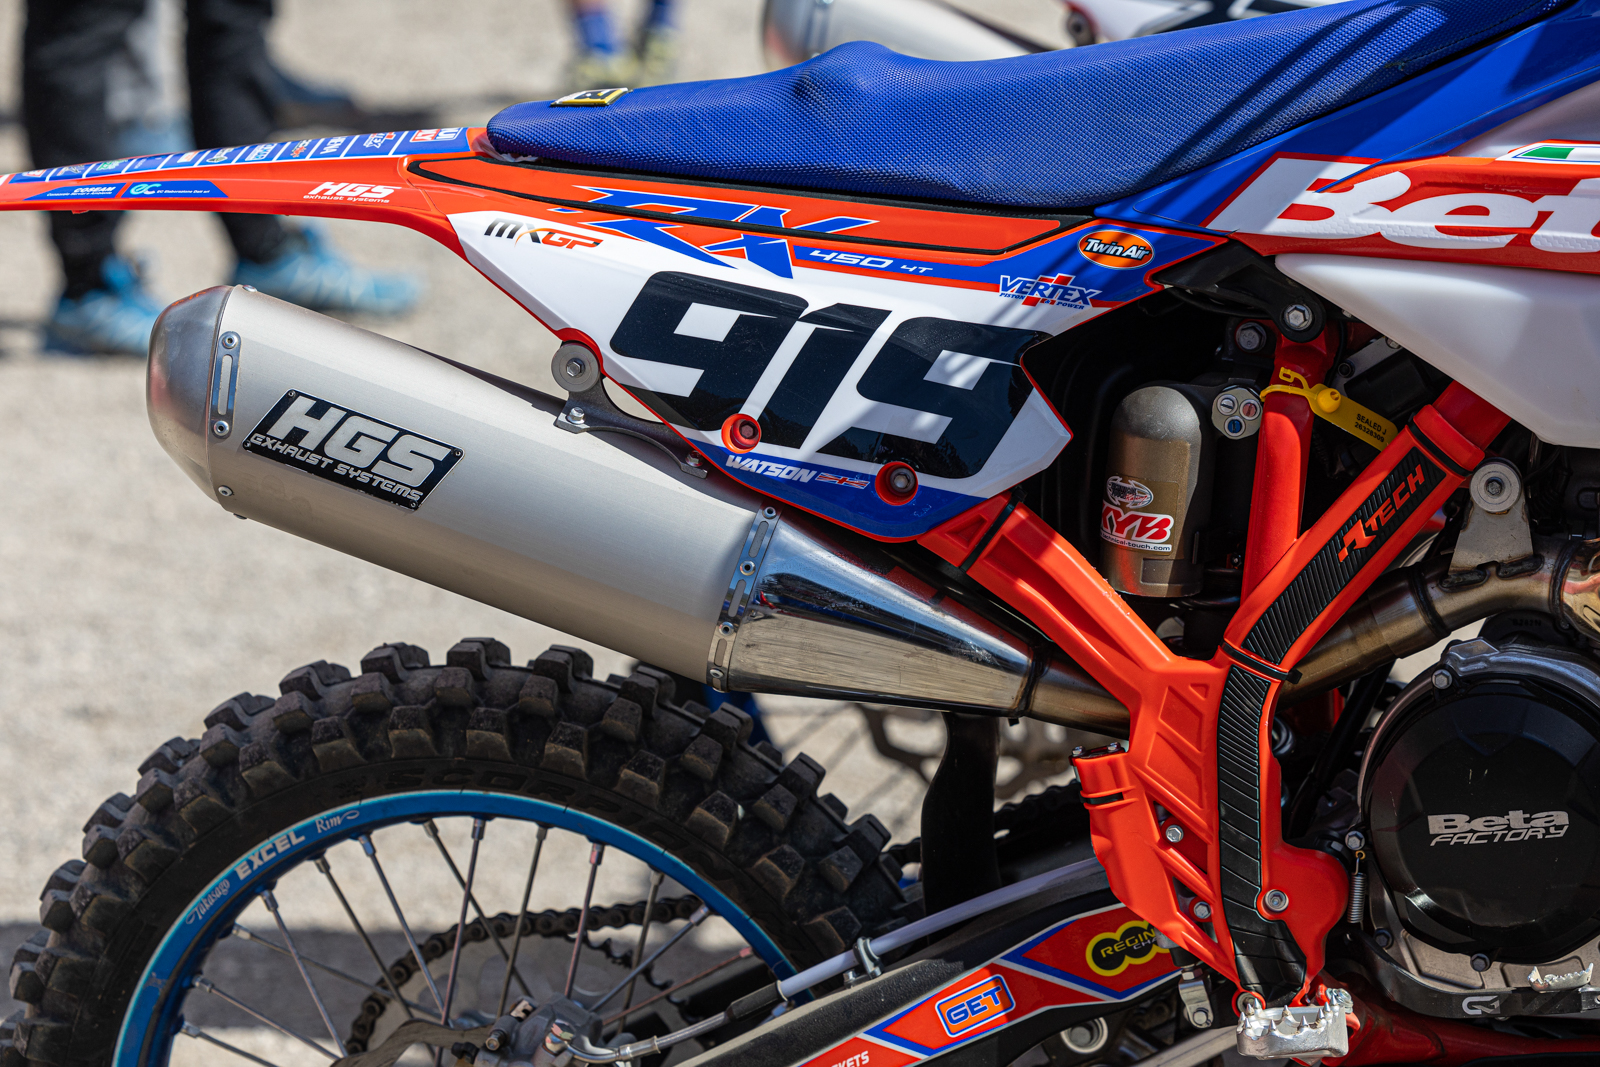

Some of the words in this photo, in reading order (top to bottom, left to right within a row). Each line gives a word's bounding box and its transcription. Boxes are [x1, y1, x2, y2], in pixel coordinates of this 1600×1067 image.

[308, 181, 402, 198] HGS
[347, 196, 390, 204] systems
[1205, 157, 1600, 253] Bet
[484, 217, 604, 250] MXGP
[809, 249, 894, 268] 450
[900, 264, 933, 274] 4T
[1085, 238, 1121, 256] Twin
[1122, 244, 1150, 260] Air
[999, 292, 1025, 300] PISTON
[1056, 301, 1084, 310] POWER
[1000, 274, 1102, 306] VERTEX
[609, 270, 1055, 480] 919
[1356, 413, 1382, 432] SEALED
[266, 395, 452, 488] HGS
[250, 432, 334, 469] EXHAUST
[333, 464, 424, 502] SYSTEMS
[725, 454, 818, 483] WATSON
[1427, 810, 1570, 835] Beta
[1430, 825, 1569, 846] FACTORY
[185, 879, 230, 925] Takasago
[234, 830, 306, 880] EXCEL
[315, 810, 360, 834] Rim
[1100, 928, 1156, 958] REGIN
[946, 985, 1002, 1025] GET
[831, 1050, 870, 1067] KETS
